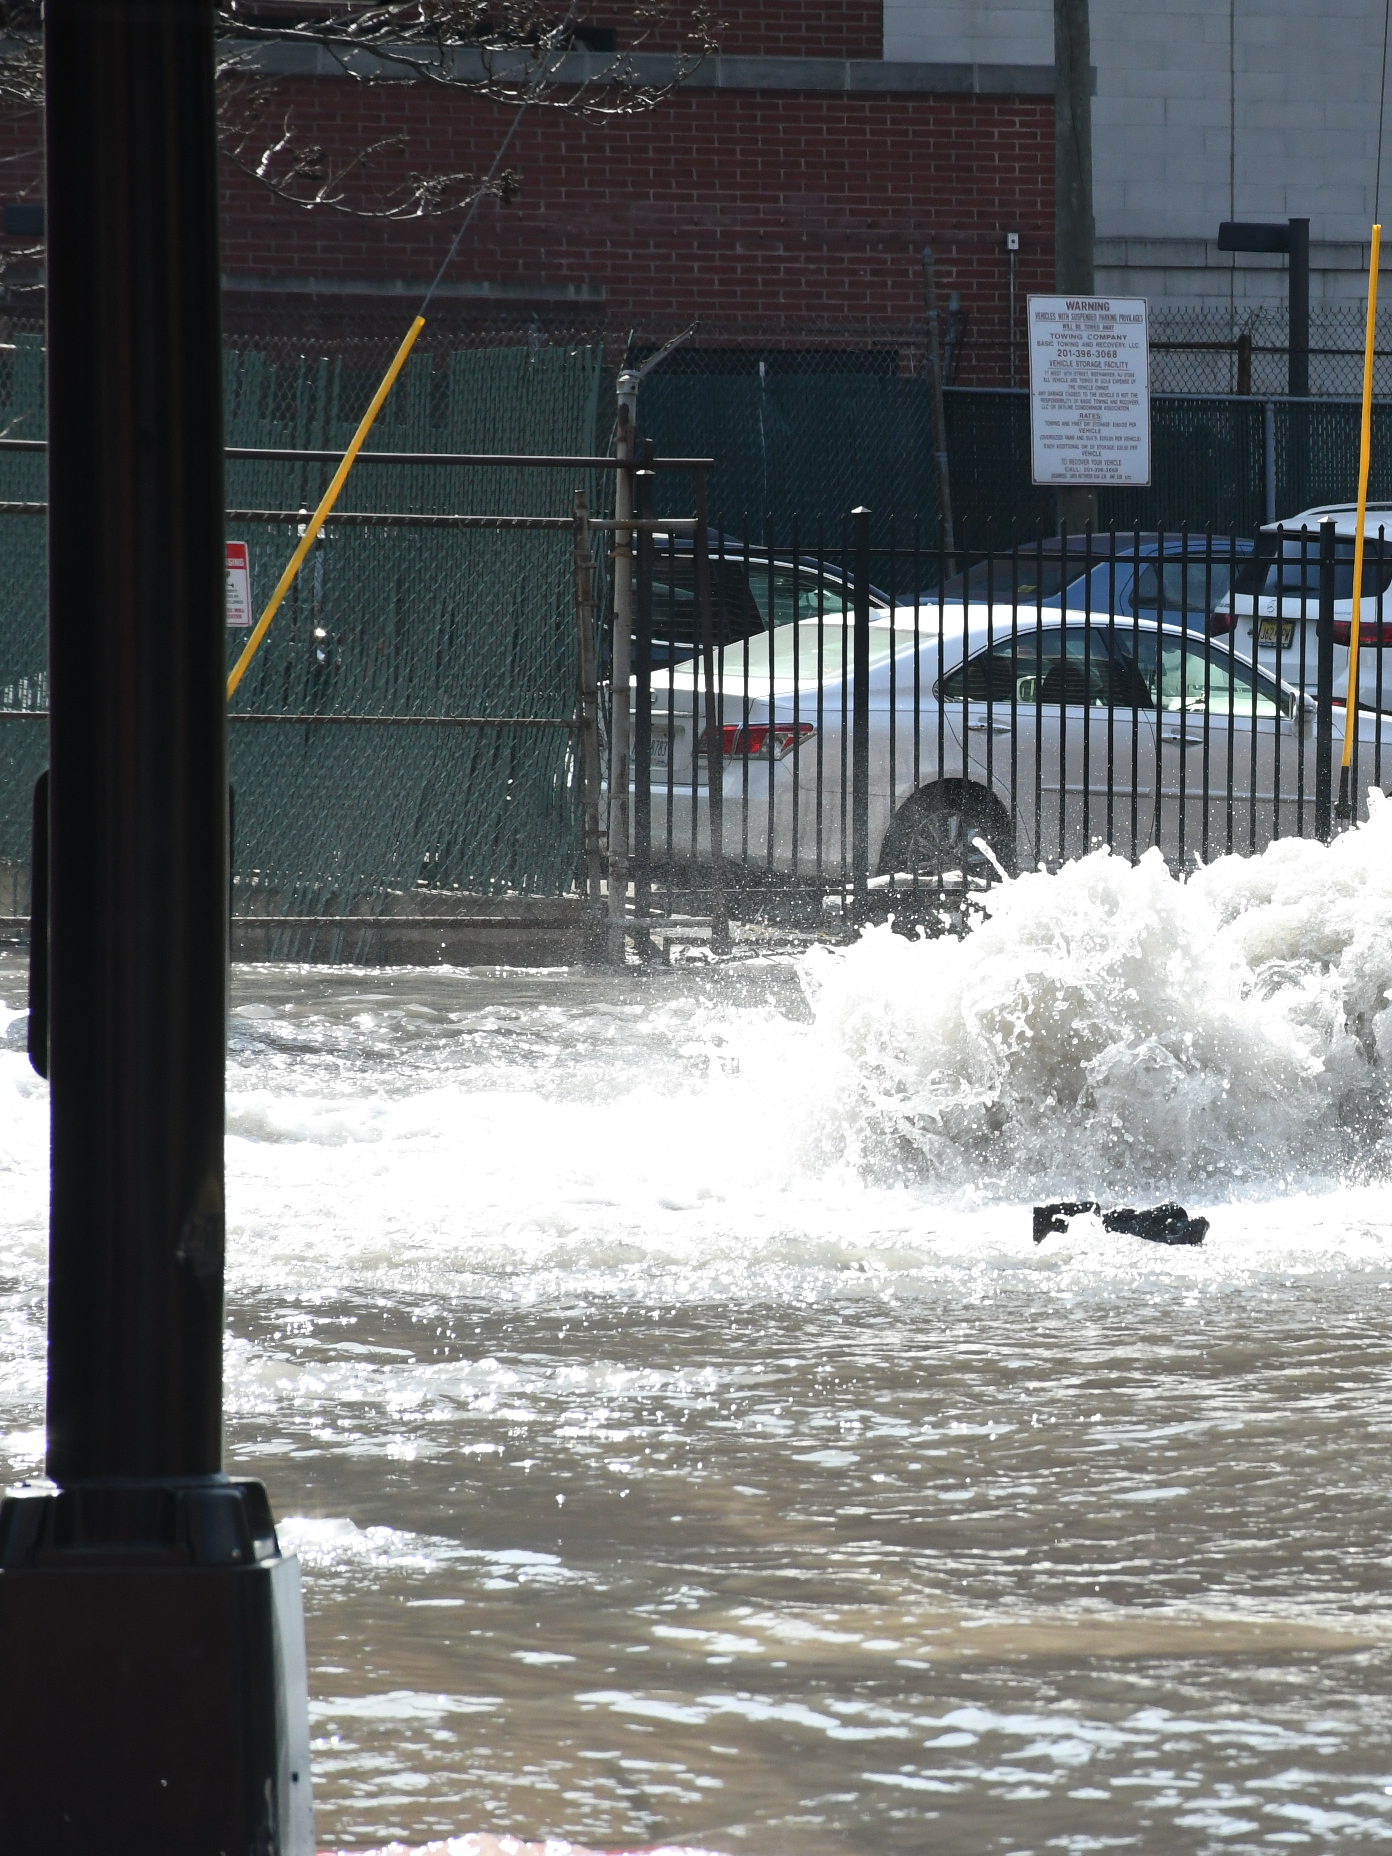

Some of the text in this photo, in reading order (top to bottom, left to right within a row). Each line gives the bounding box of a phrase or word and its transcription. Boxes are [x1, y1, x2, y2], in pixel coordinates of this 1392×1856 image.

[1066, 301, 1110, 311] WARNING
[1035, 312, 1056, 320] VEHICLES
[1071, 313, 1097, 321] SUSPENDED
[1088, 333, 1127, 341] COMPANY
[1057, 349, 1118, 358] 201-396-3068
[1049, 360, 1129, 369] VEHICLE STORAGE FACILITY
